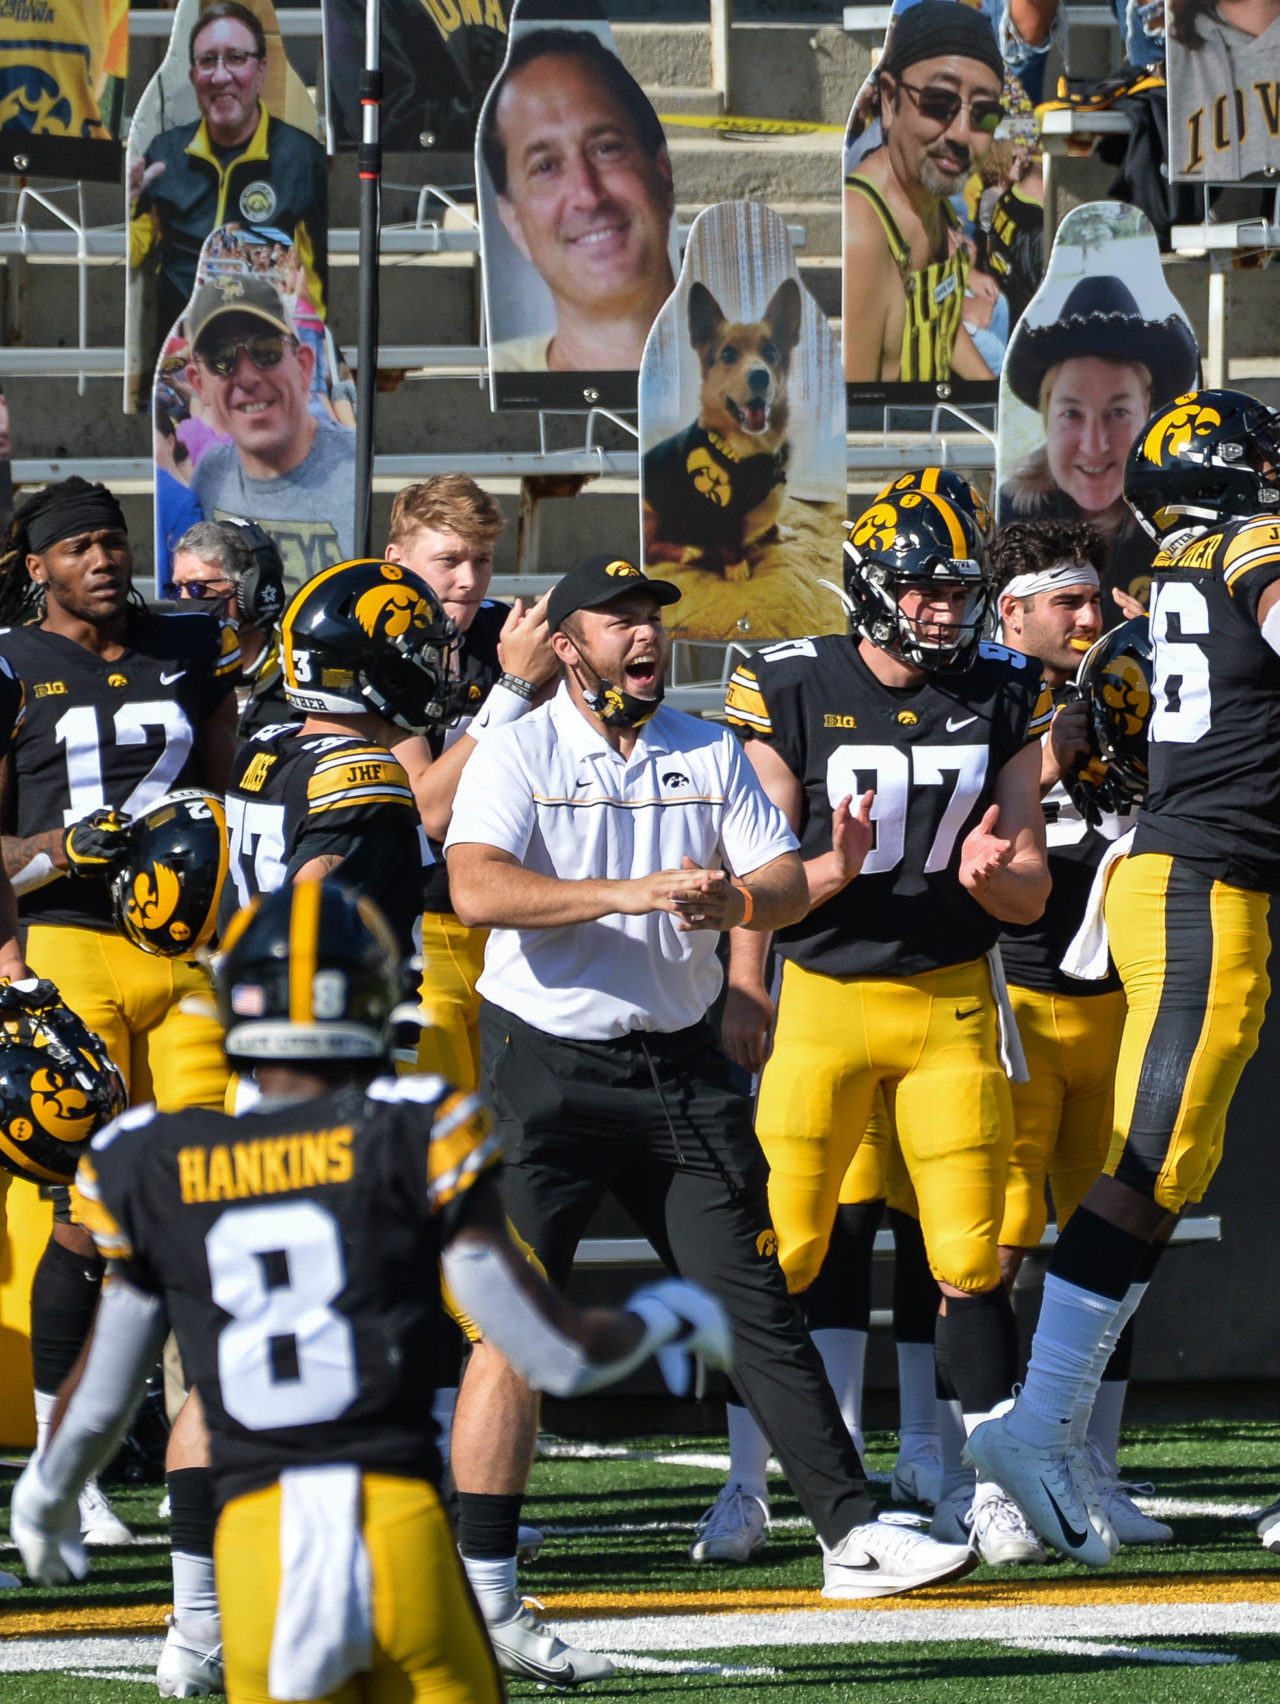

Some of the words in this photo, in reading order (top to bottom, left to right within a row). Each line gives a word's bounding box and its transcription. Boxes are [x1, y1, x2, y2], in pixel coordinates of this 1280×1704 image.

[292, 650, 312, 683] 3
[1147, 582, 1211, 743] 6
[55, 700, 194, 833] 12
[347, 764, 382, 783] JHF
[827, 744, 990, 875] 97
[312, 969, 348, 1019] 8
[178, 1126, 355, 1204] HANKINS
[204, 1199, 360, 1431] 8
